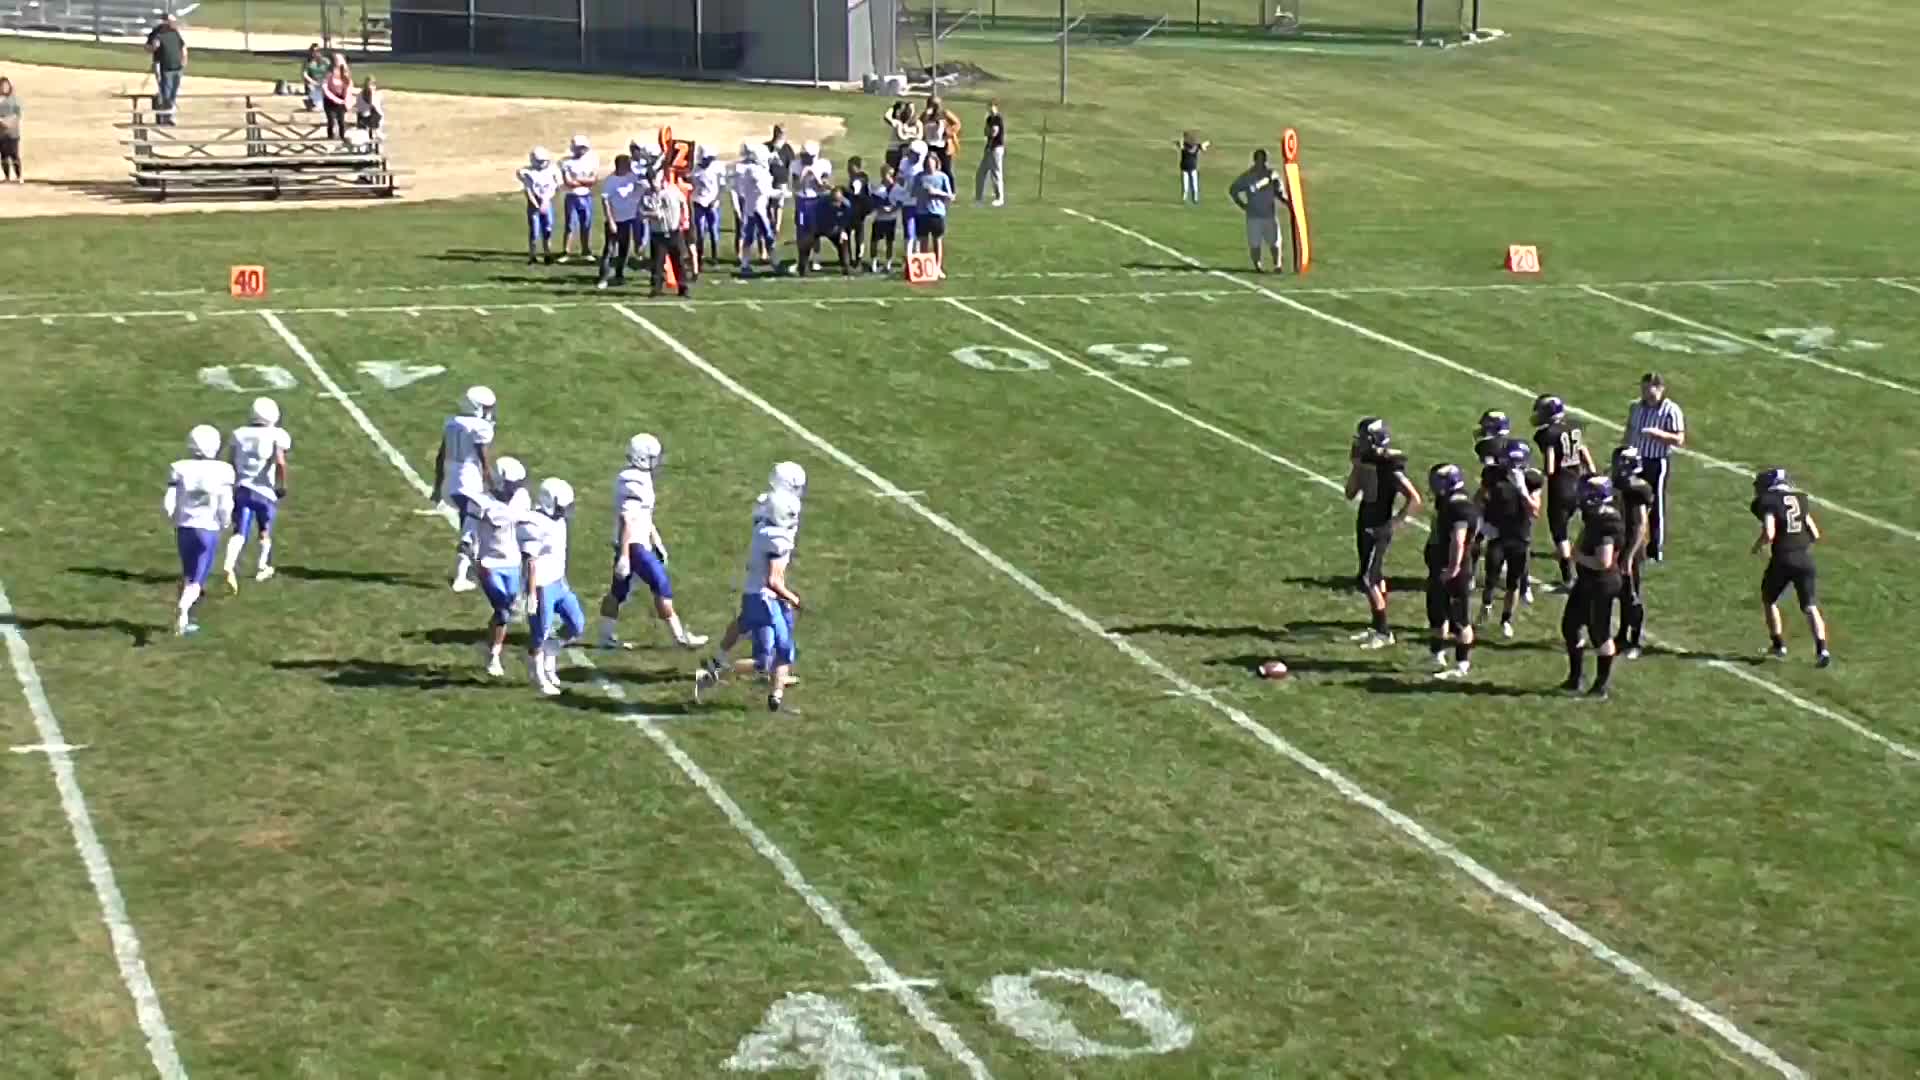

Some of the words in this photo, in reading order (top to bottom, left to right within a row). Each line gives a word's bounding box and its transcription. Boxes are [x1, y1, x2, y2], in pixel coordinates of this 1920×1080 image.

[673, 142, 688, 168] 2
[911, 257, 934, 278] 30
[1513, 249, 1535, 270] 20
[235, 270, 260, 292] 40
[1783, 494, 1802, 533] 2
